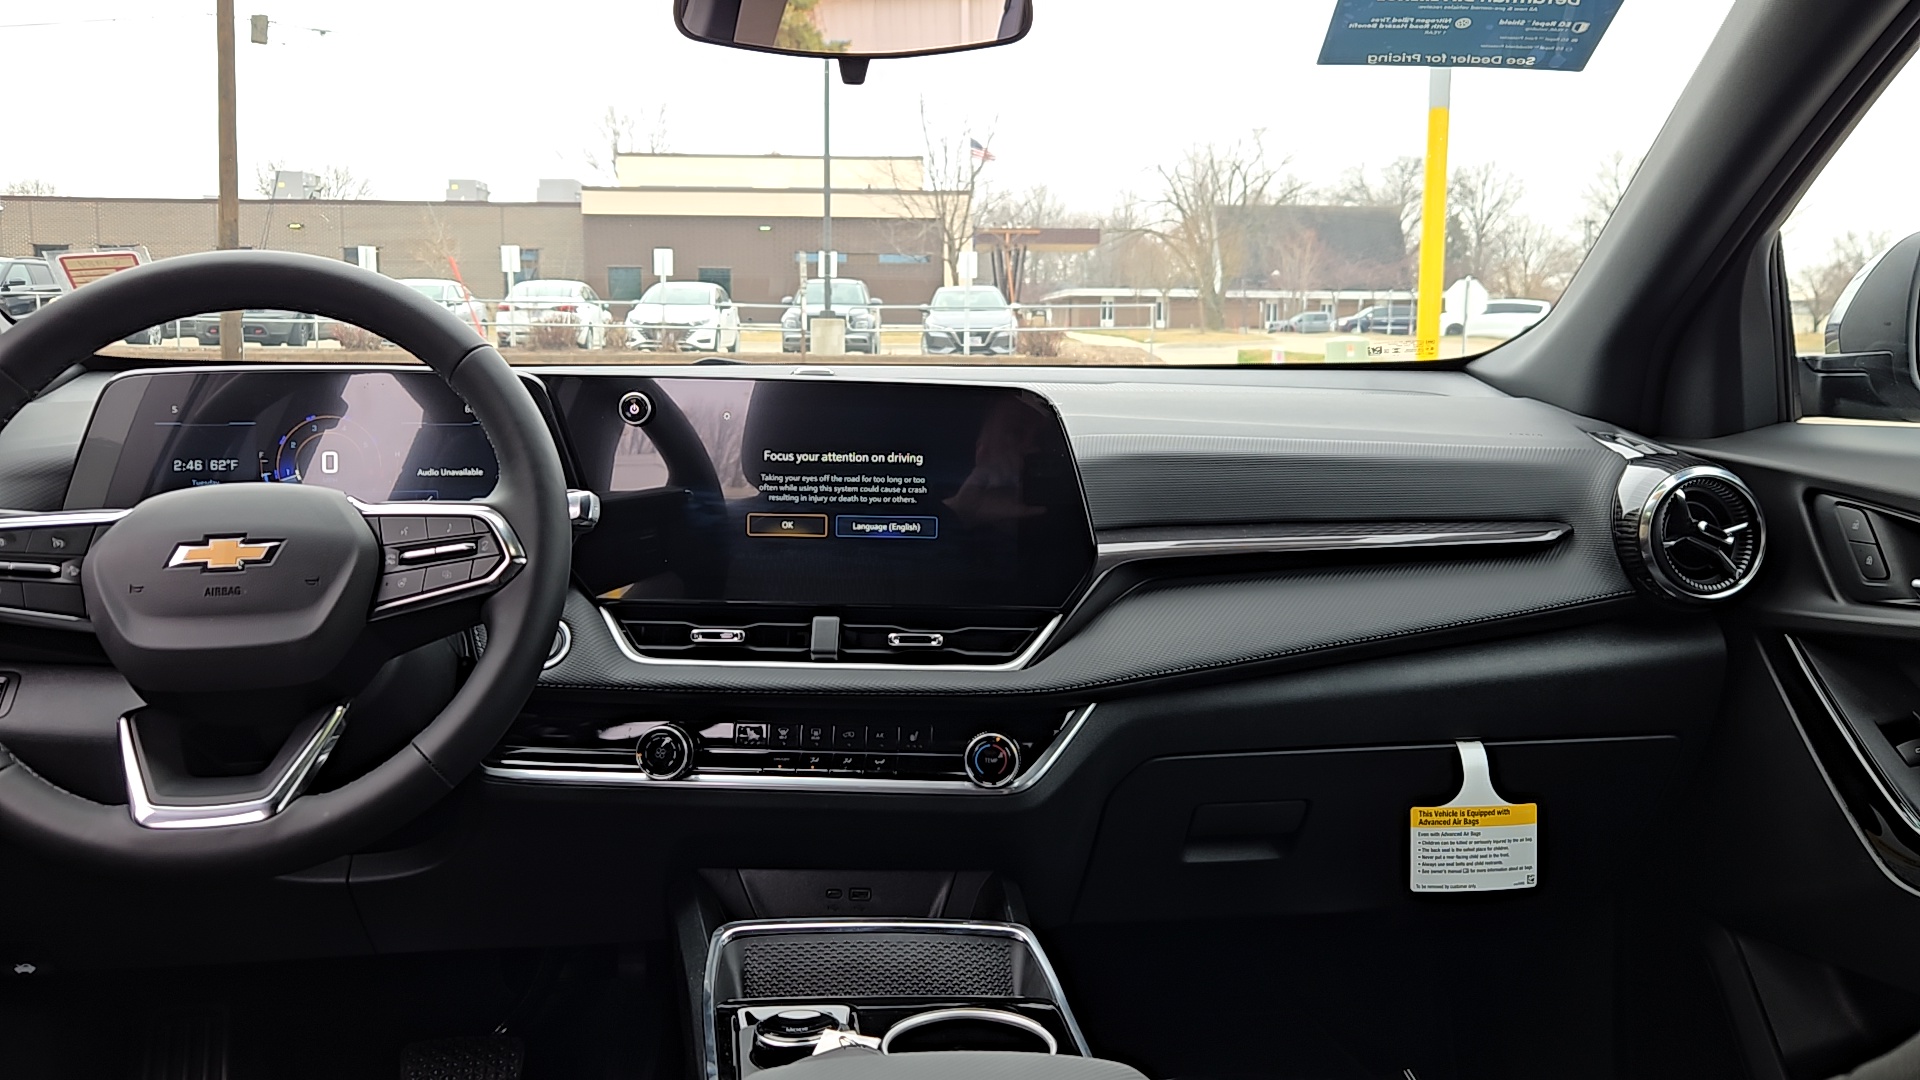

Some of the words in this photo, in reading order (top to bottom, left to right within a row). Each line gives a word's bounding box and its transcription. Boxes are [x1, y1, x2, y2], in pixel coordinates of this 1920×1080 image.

[321, 451, 339, 474] 0
[763, 449, 795, 462] Focus
[796, 452, 820, 465] your
[821, 451, 869, 463] attention
[871, 454, 885, 463] on
[887, 452, 924, 466] driving
[173, 459, 203, 472] 2:46
[210, 459, 239, 472] 62°F
[417, 467, 439, 476] Audio
[440, 467, 484, 476] Unavailable
[760, 473, 783, 483] Taking
[784, 475, 801, 483] your
[802, 475, 818, 484] eyes
[819, 474, 830, 482] off
[831, 475, 843, 483] the
[844, 475, 860, 483] road
[861, 475, 872, 483] for
[873, 476, 886, 484] too
[887, 475, 902, 485] long
[779, 484, 798, 492] while
[799, 485, 818, 493] using
[819, 484, 833, 492] this
[834, 486, 858, 494] system
[860, 485, 879, 493] could
[908, 486, 927, 494] crash
[768, 494, 799, 503] resulting
[808, 495, 828, 504] injury
[838, 495, 859, 503] death
[892, 496, 917, 504] others.
[781, 520, 794, 530] OK
[852, 521, 887, 533] Language
[888, 522, 921, 533] (English)
[204, 586, 241, 597] AIRBAG
[1466, 809, 1496, 818] Equipped
[1464, 818, 1480, 826] Bags
